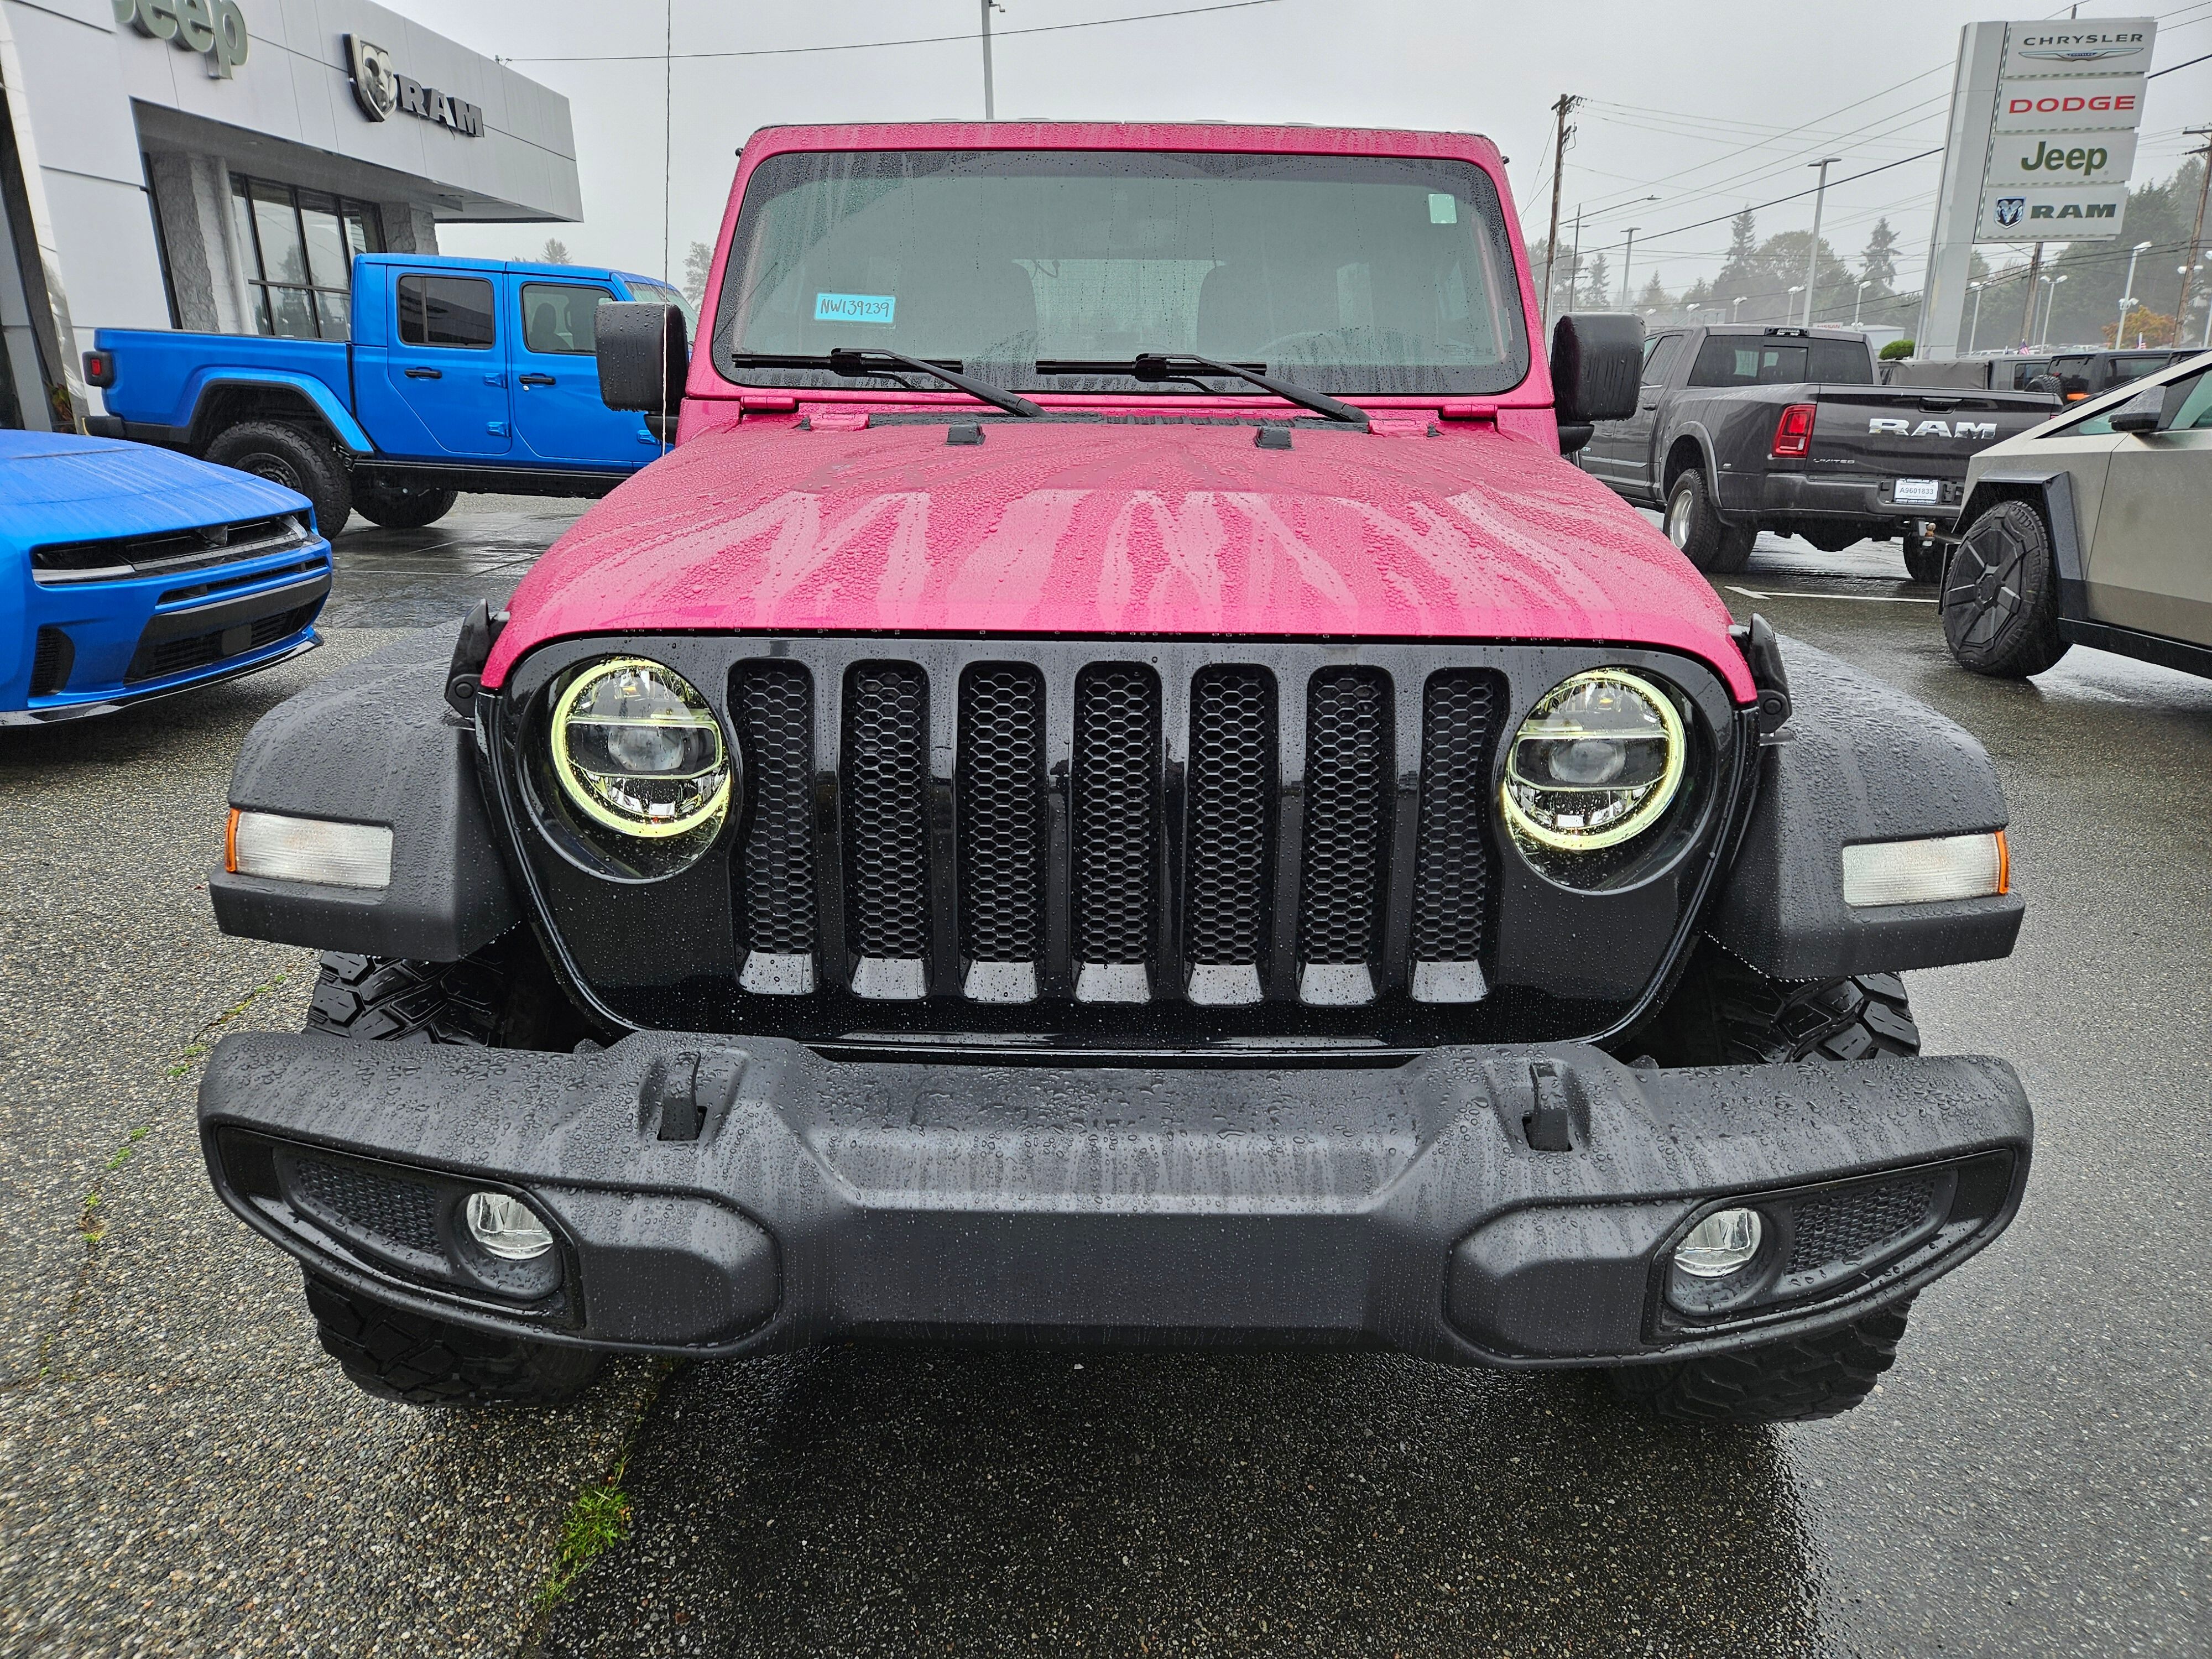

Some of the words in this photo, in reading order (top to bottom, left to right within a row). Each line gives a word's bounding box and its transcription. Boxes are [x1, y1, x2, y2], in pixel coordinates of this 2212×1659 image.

[2023, 34, 2143, 45] CHRYSLER
[393, 74, 484, 137] RAM
[2009, 96, 2135, 113] DODGE
[2021, 141, 2107, 176] Jeep
[2030, 204, 2116, 218] RAM
[820, 298, 890, 317] NW139239
[1869, 418, 1997, 439] RAM
